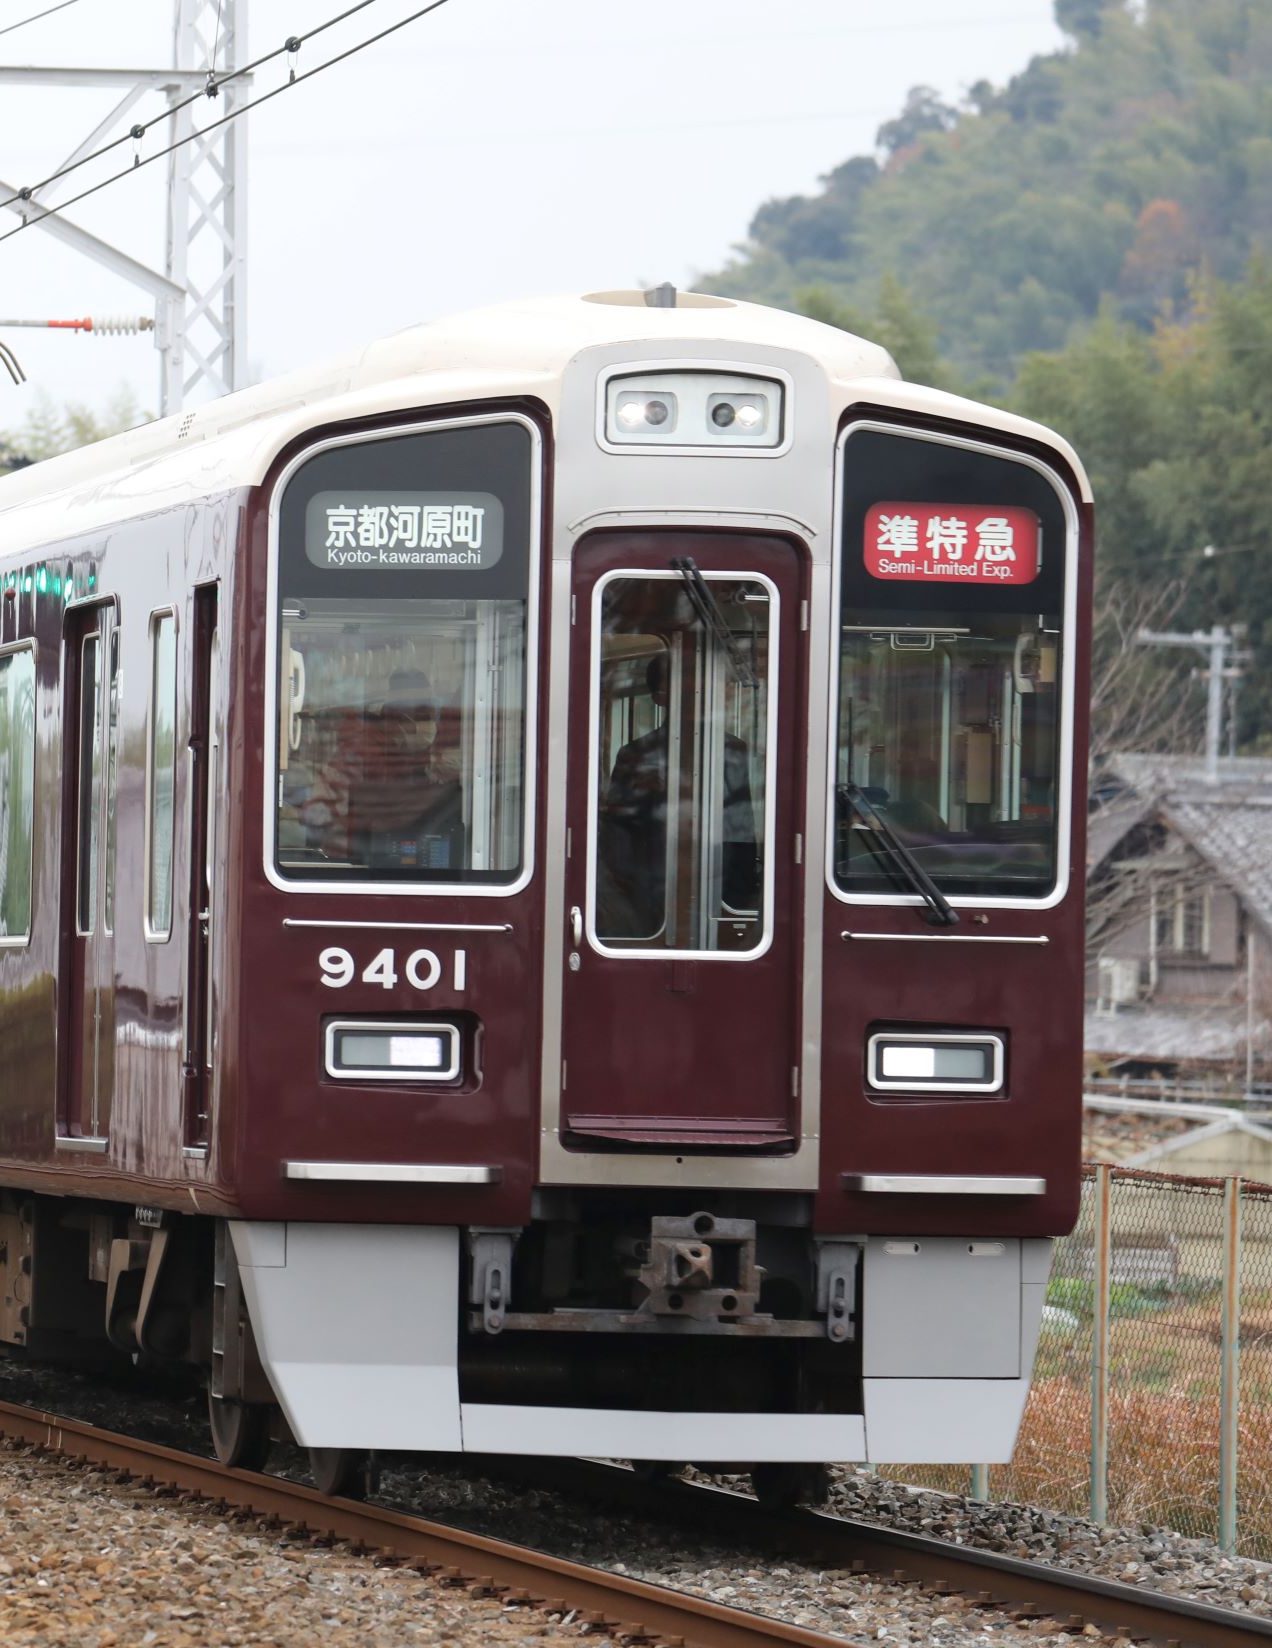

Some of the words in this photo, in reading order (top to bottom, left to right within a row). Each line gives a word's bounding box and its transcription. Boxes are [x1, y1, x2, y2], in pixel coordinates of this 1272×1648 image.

[325, 504, 485, 549] 京都河原町
[876, 514, 1017, 562] 準特急
[327, 548, 482, 566] Kyoto-kawaramachi
[878, 558, 978, 577] Semi-Limited
[982, 561, 1014, 580] Exp.
[318, 946, 466, 991] 9401
